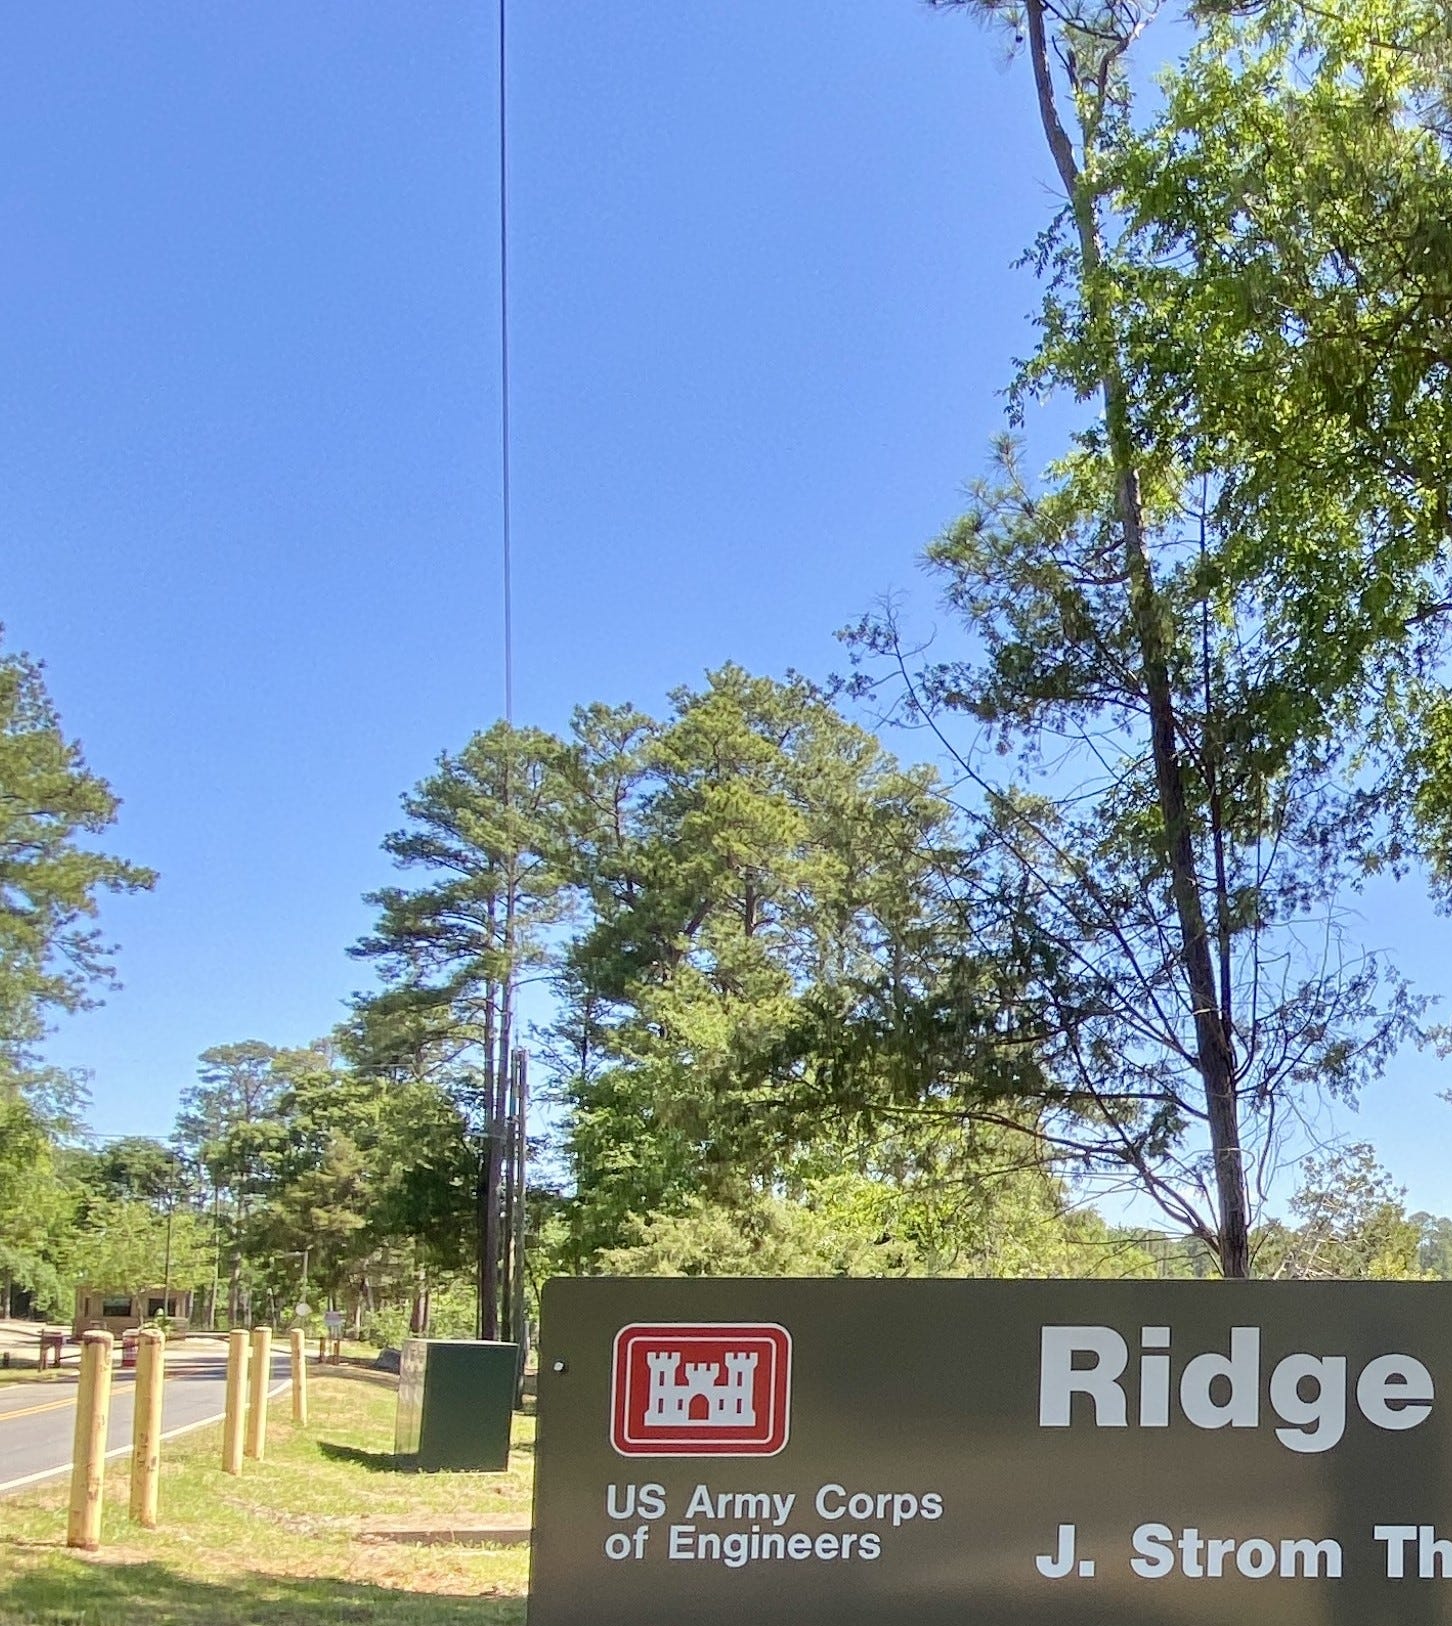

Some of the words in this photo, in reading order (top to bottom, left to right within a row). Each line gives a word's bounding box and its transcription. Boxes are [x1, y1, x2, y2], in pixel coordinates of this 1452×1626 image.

[1038, 1326, 1435, 1454] Ridge
[606, 1483, 667, 1520] US
[685, 1484, 796, 1526] Army
[814, 1483, 944, 1527] Corps
[604, 1525, 650, 1560] of
[667, 1525, 882, 1569] Engineers
[1034, 1524, 1096, 1579] J.
[1129, 1523, 1343, 1579] Strom
